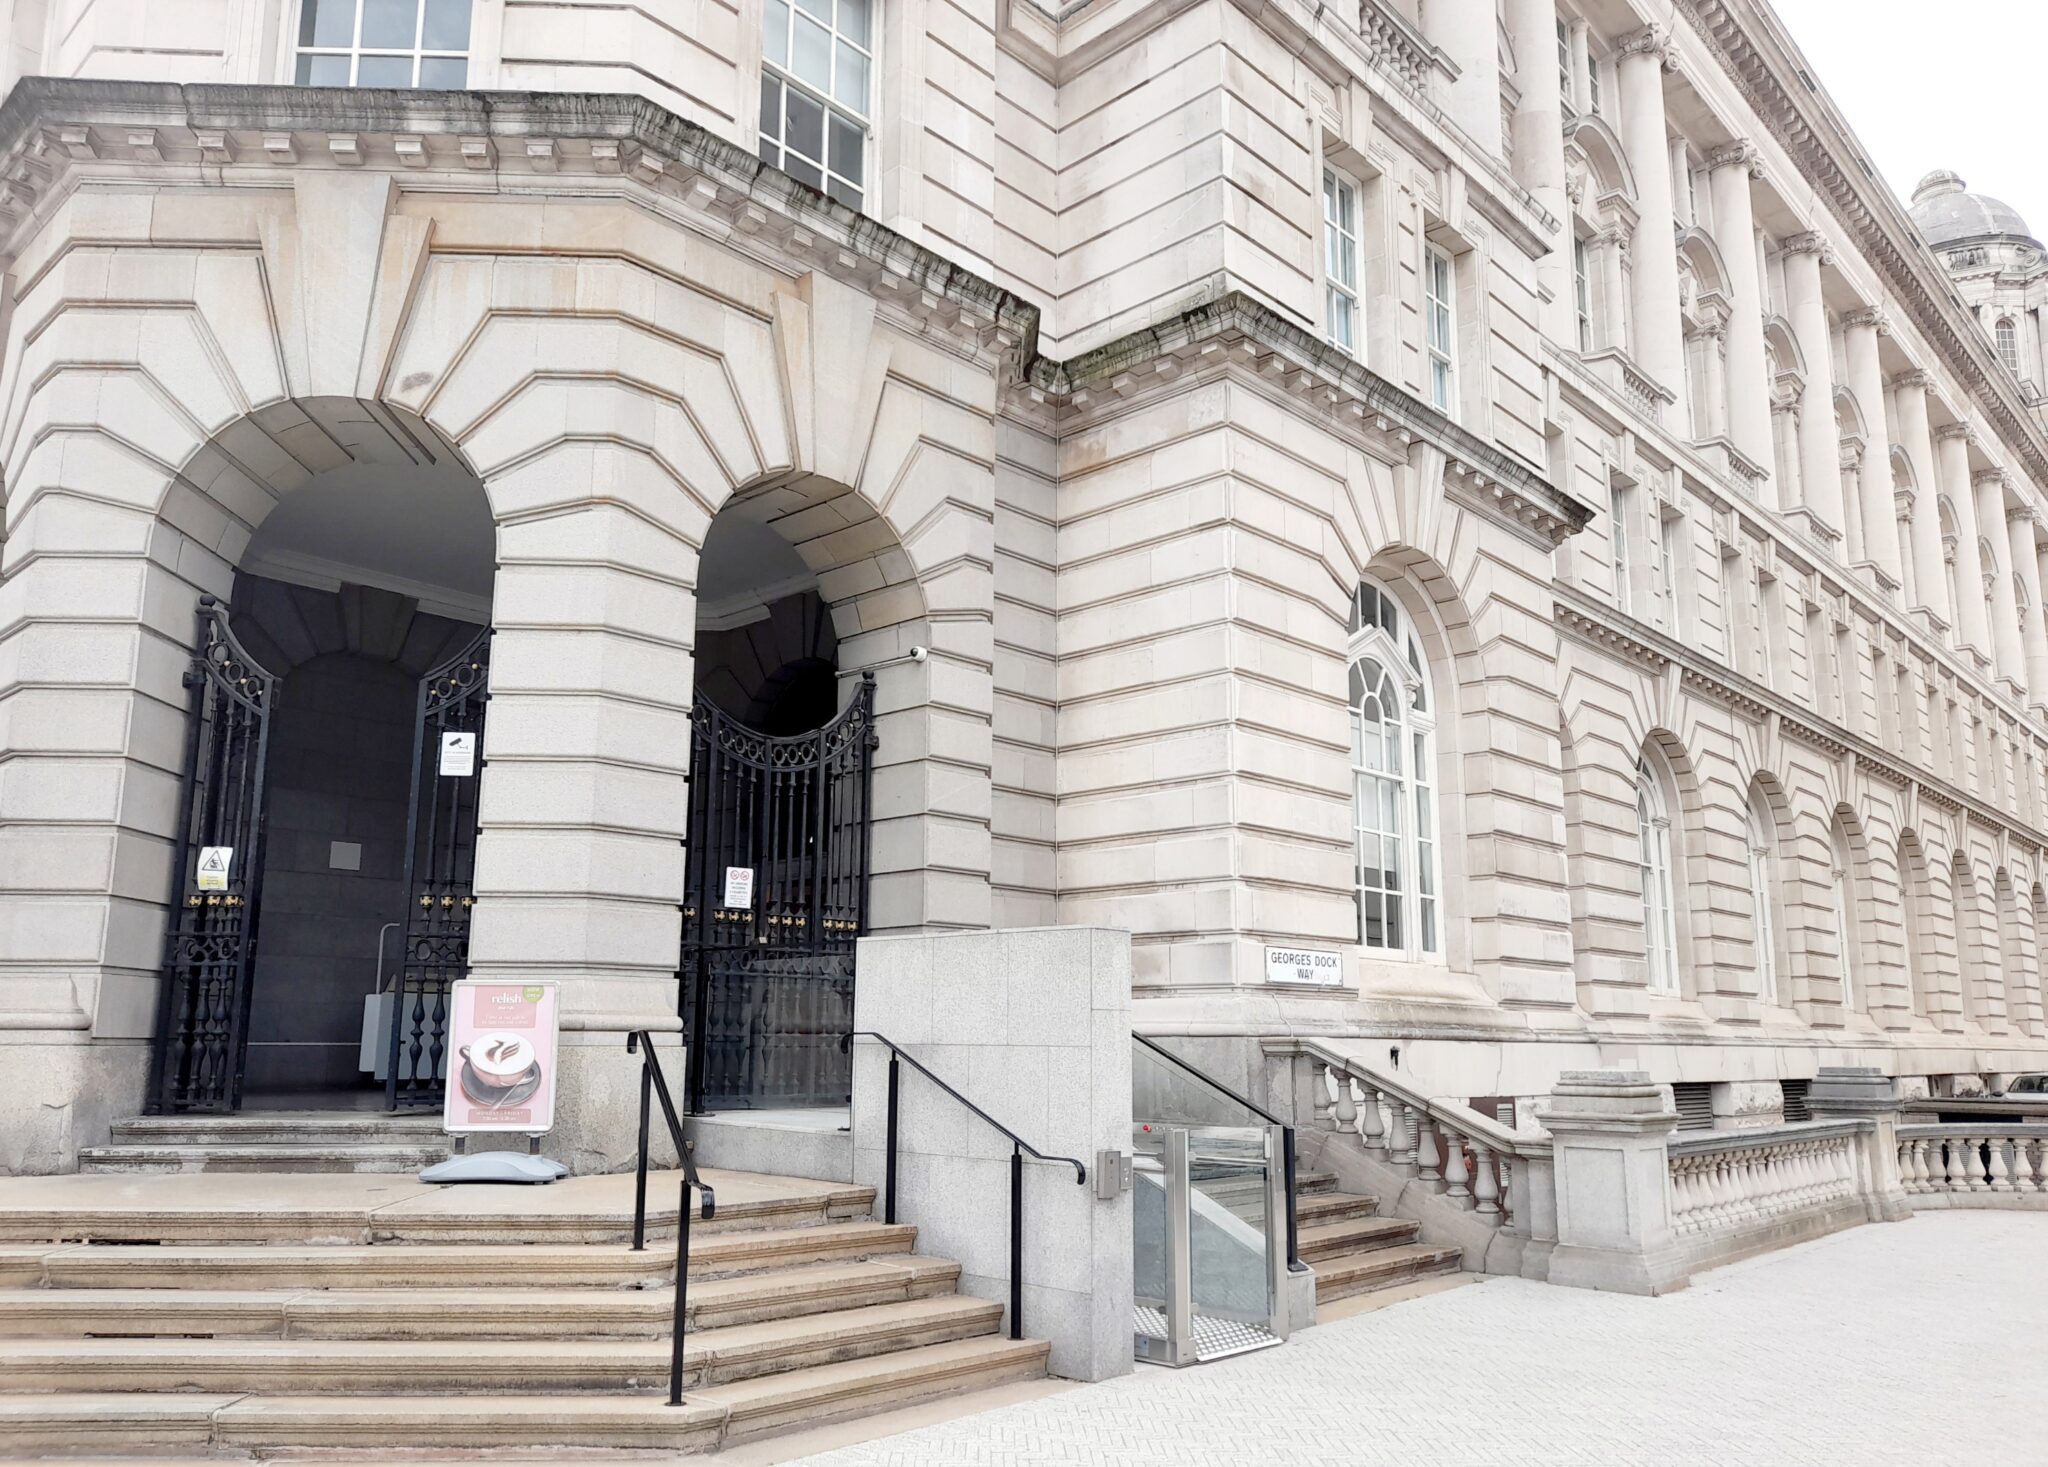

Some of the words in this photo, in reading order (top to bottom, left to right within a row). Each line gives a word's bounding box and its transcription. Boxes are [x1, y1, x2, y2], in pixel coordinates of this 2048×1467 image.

[1271, 952, 1311, 966] GEORGES
[1314, 956, 1338, 968] DOCK
[1297, 968, 1314, 980] WAY
[491, 992, 521, 1004] relish
